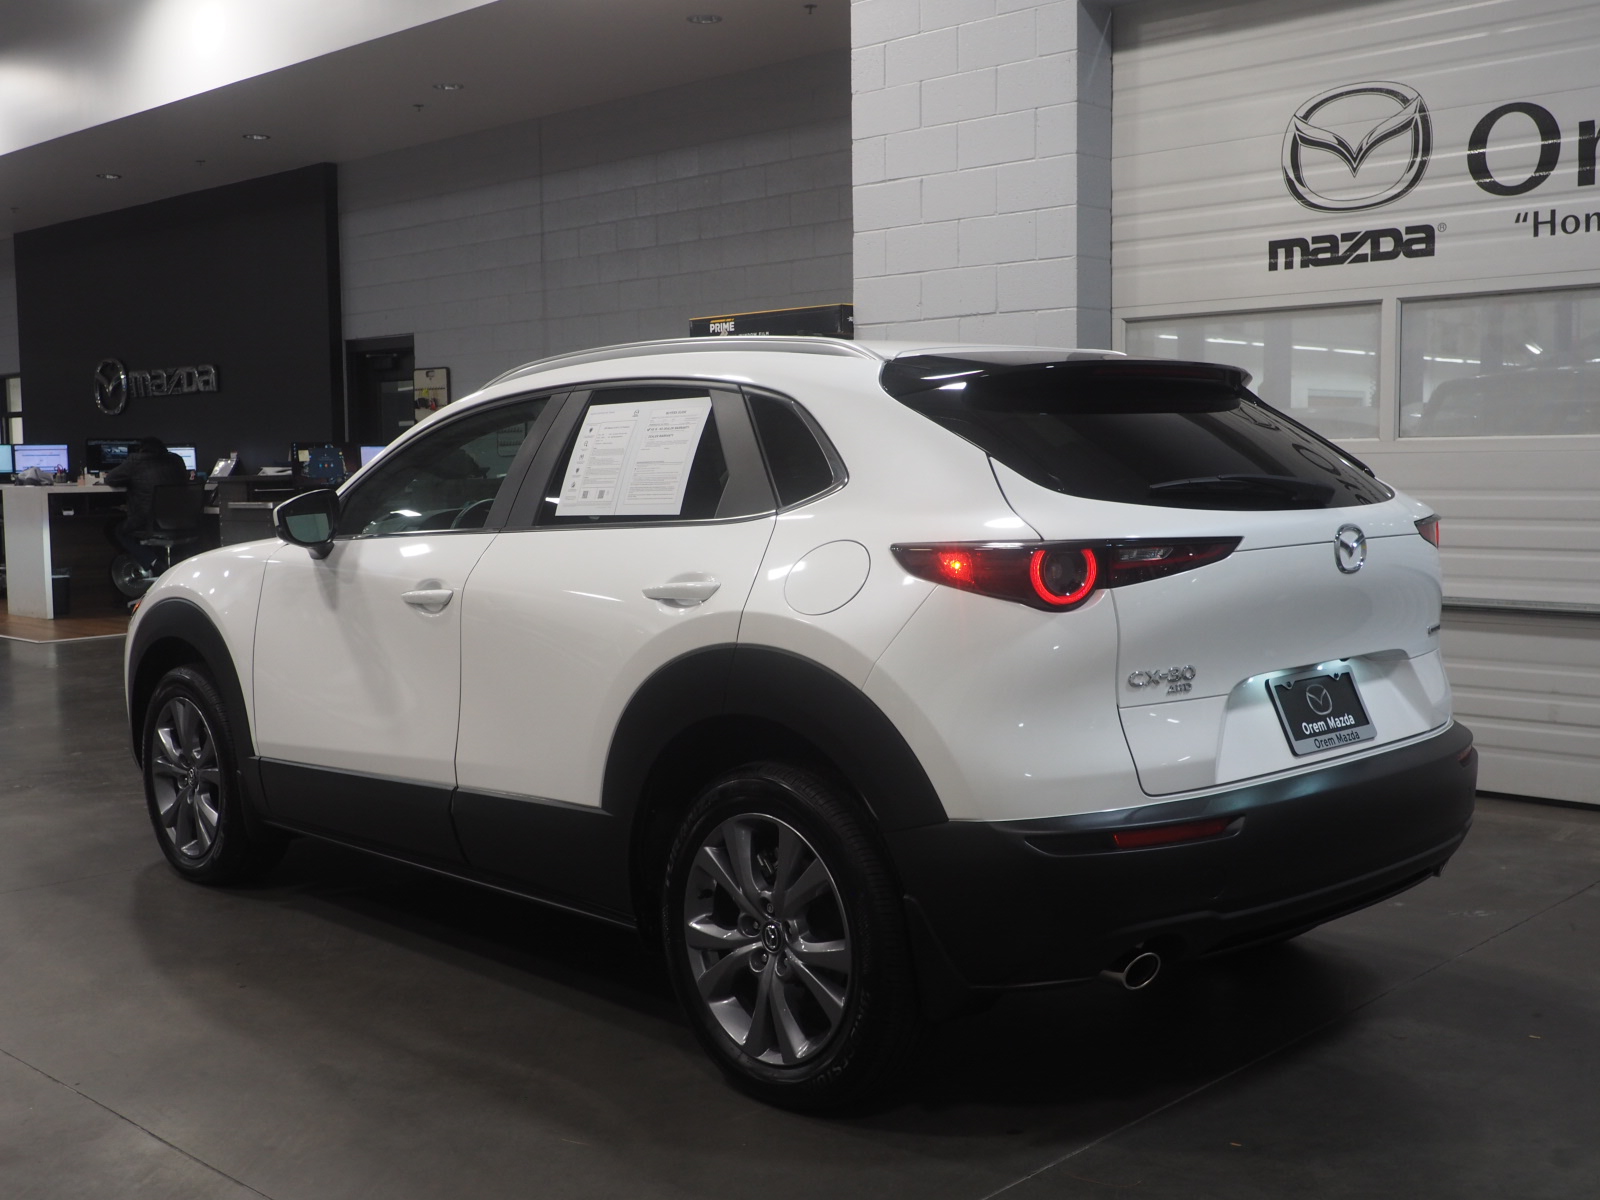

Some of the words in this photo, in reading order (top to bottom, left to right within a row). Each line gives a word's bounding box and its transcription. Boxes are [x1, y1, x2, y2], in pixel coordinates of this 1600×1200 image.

[709, 321, 735, 333] PRIME
[128, 364, 216, 397] mazda
[1127, 664, 1197, 688] CX-30
[1301, 720, 1327, 735] Orem
[1326, 713, 1355, 729] Mazda
[1313, 737, 1336, 749] Orem
[1335, 730, 1360, 744] Mazda
